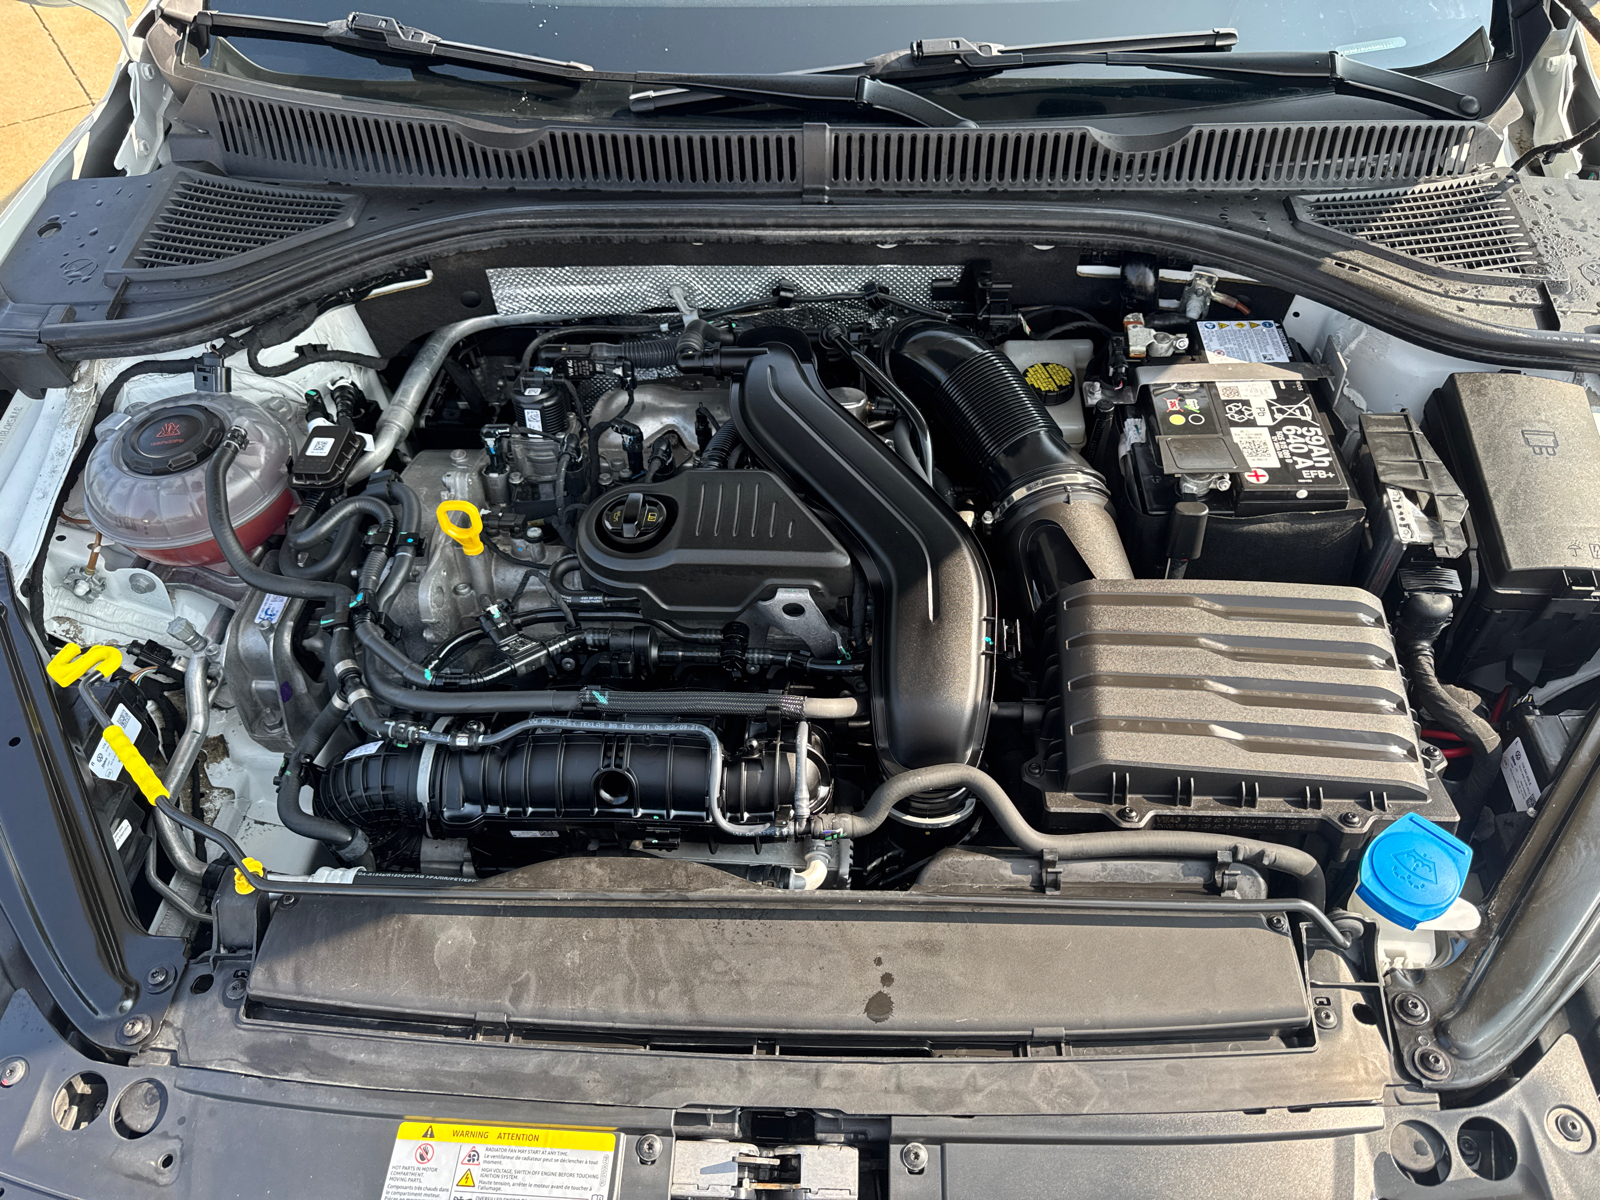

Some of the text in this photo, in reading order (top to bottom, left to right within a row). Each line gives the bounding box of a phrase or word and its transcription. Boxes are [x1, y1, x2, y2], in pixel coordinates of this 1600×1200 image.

[1255, 407, 1266, 417] Pb
[1282, 425, 1309, 454] 640
[1301, 427, 1333, 467] 59Ah
[1292, 456, 1314, 469] A
[1302, 470, 1335, 479] EFB+
[452, 1129, 539, 1142] WARNING ATTENTION
